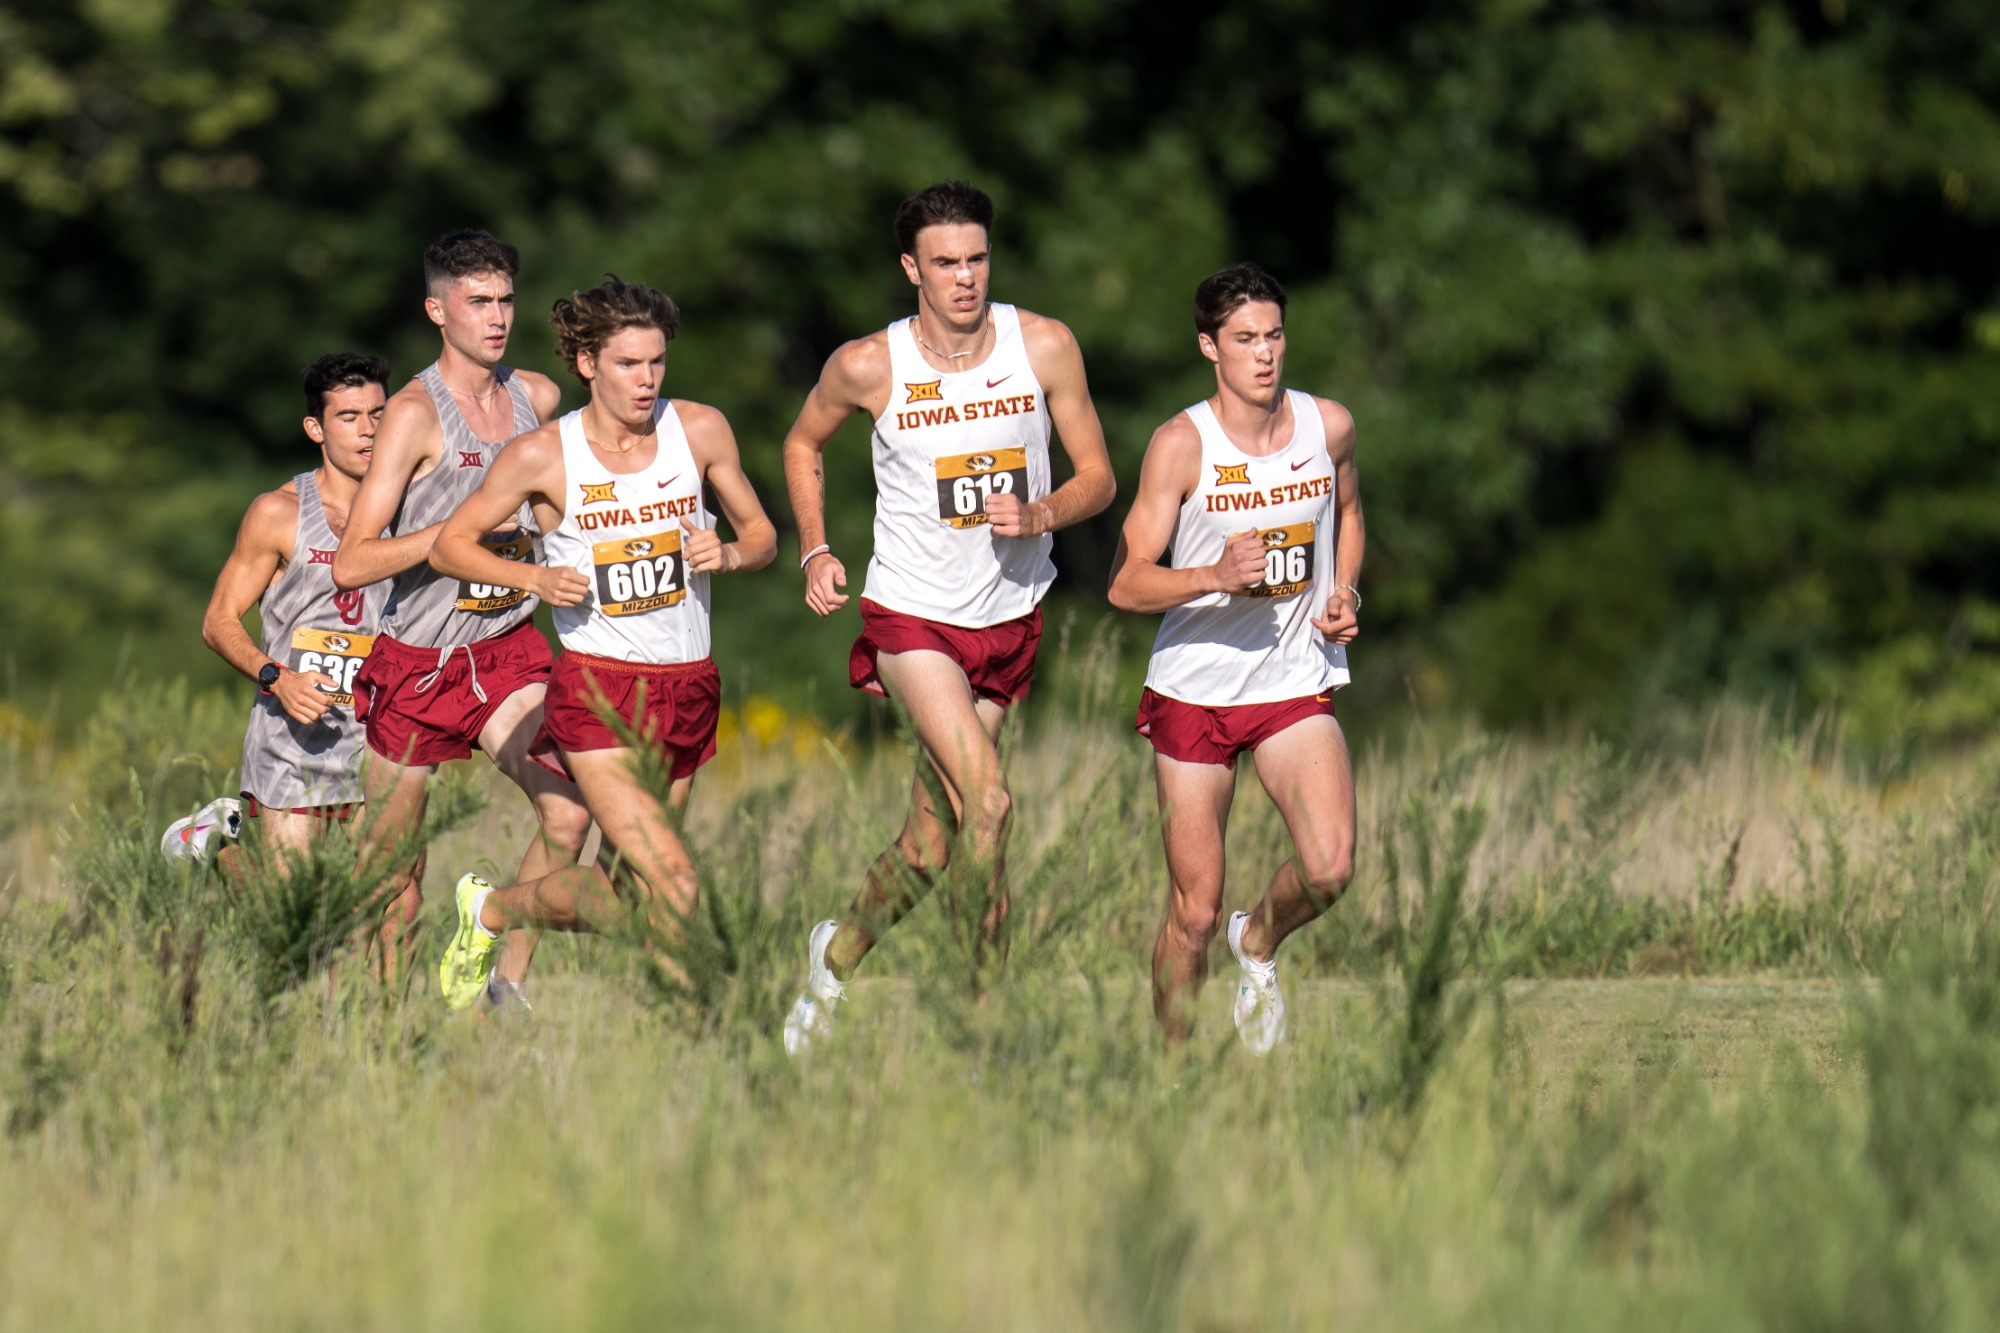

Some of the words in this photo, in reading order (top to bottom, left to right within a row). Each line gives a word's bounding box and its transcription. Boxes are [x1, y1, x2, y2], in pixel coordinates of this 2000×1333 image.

[904, 379, 944, 404] XII
[897, 406, 960, 430] IOWA
[963, 394, 1035, 421] STATE
[458, 450, 484, 468] XII
[1213, 463, 1251, 487] XII
[579, 480, 619, 506] XII
[953, 471, 1014, 515] 612
[1206, 490, 1267, 512] IOWA
[1270, 476, 1332, 505] STATE
[575, 508, 636, 531] IOWA
[639, 495, 697, 523] STATE
[608, 555, 677, 602] 602
[1249, 545, 1306, 588] 06
[477, 594, 520, 609] MIZZOU
[621, 595, 670, 613] MIZZOU
[1250, 585, 1298, 598] MIZZOU
